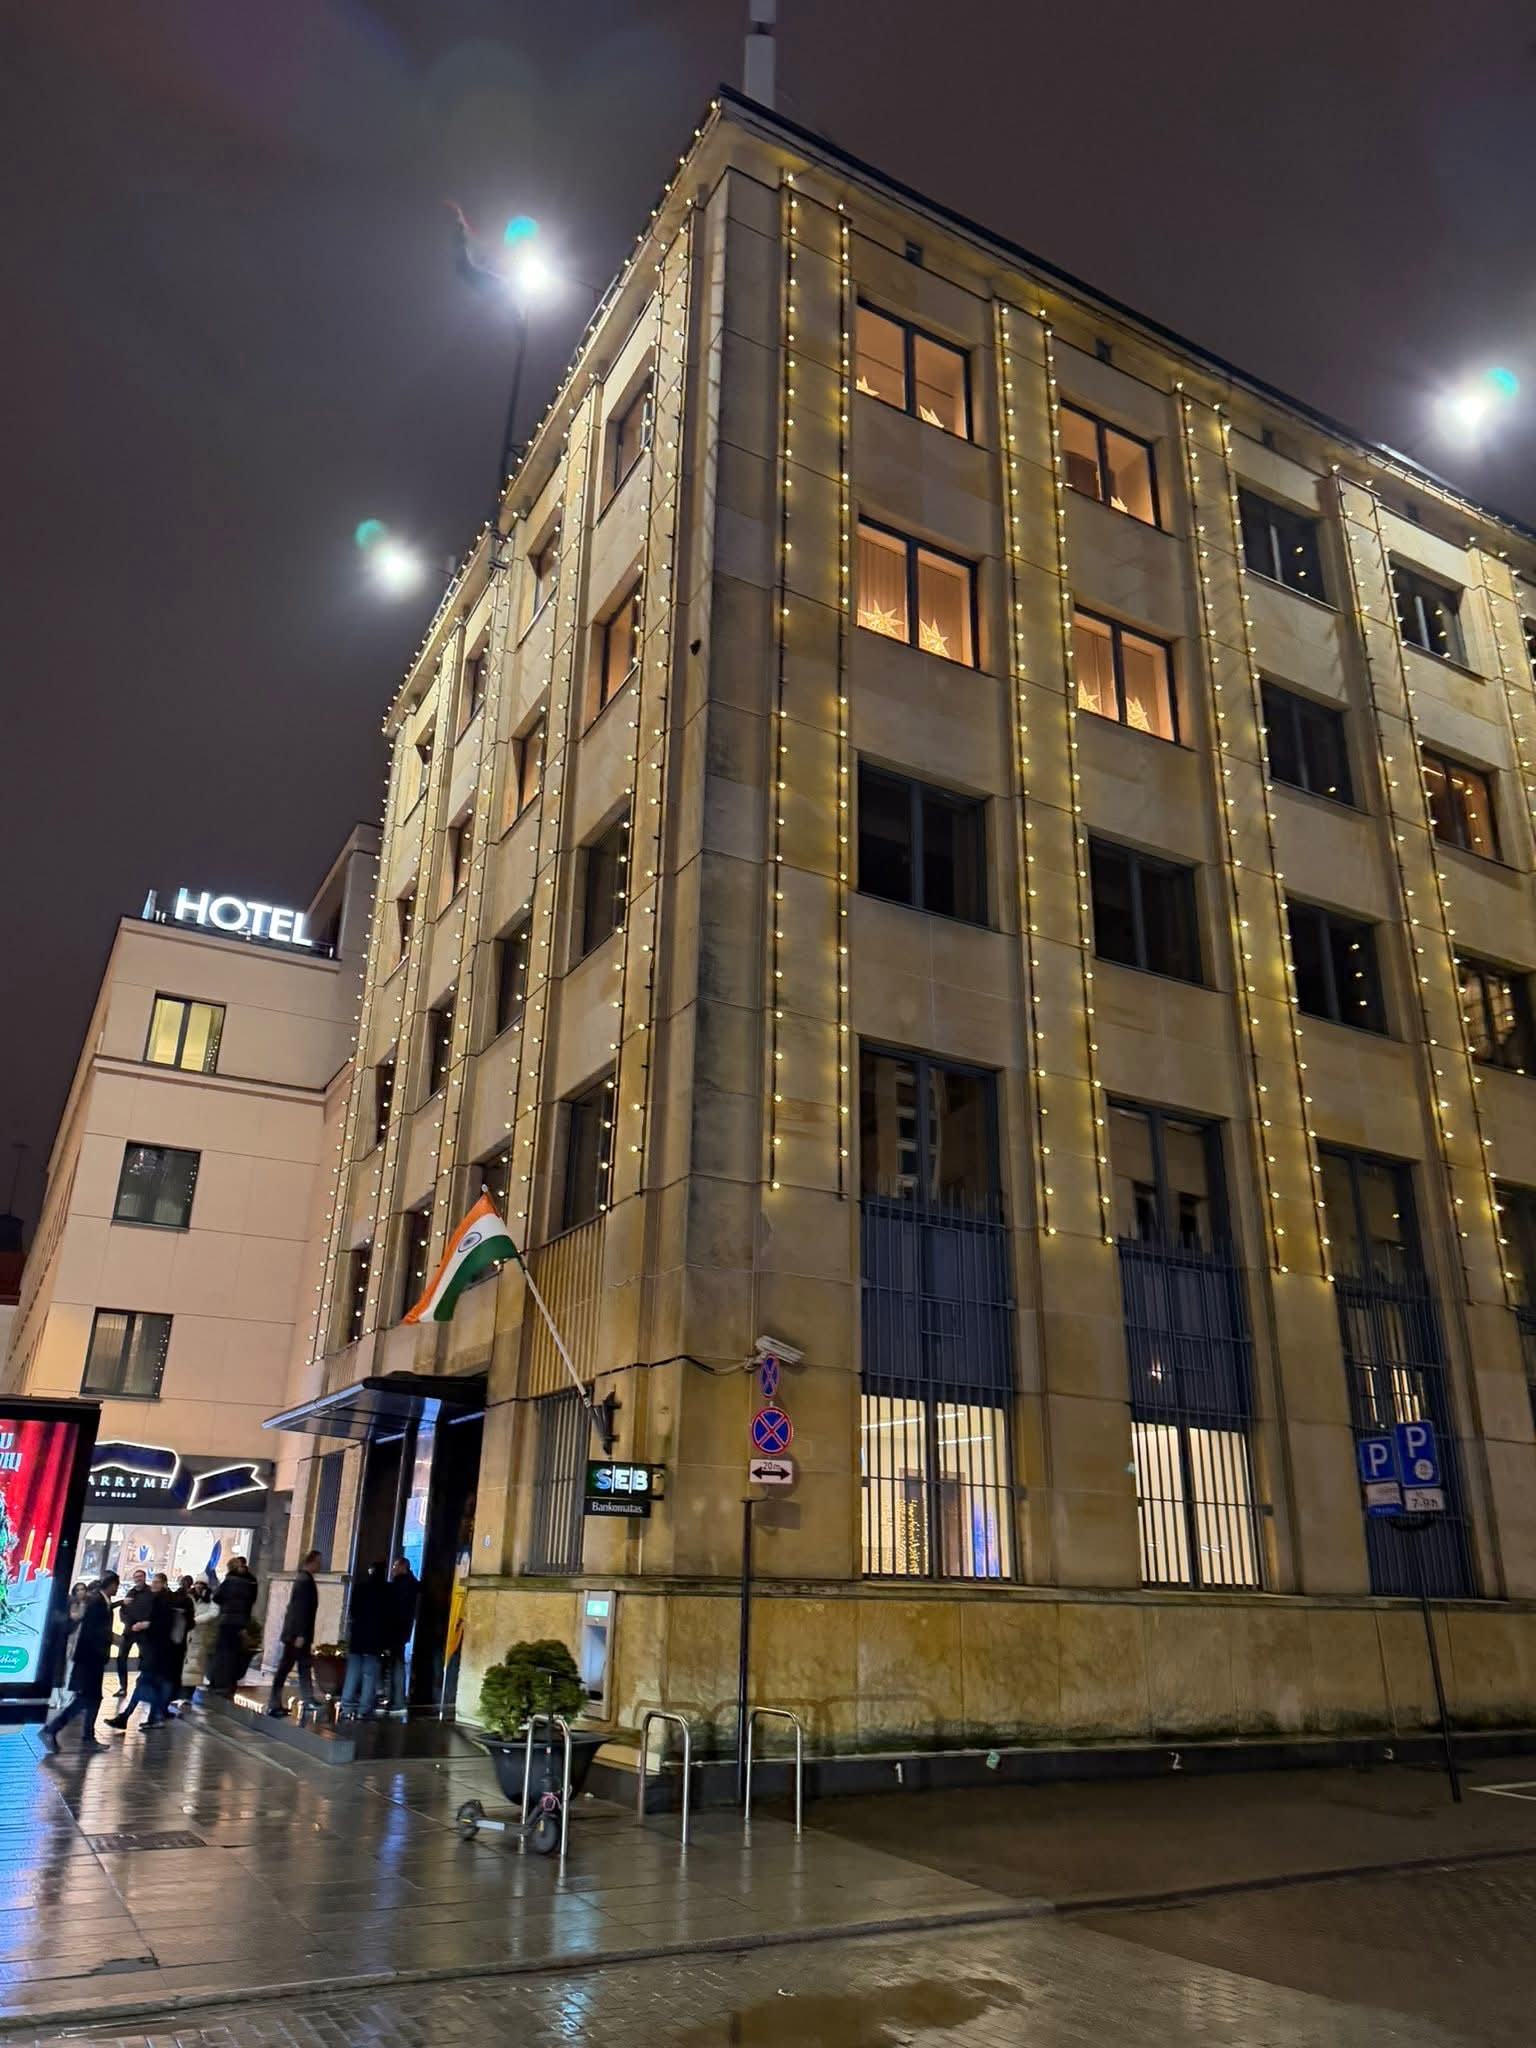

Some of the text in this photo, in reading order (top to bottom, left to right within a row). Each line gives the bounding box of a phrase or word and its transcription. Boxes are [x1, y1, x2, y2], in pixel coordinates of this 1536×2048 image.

[174, 887, 312, 946] HOTEL
[1406, 1426, 1427, 1458] P
[1368, 1443, 1388, 1476] P
[595, 1467, 648, 1491] SEB
[592, 1501, 643, 1513] Bankomatas
